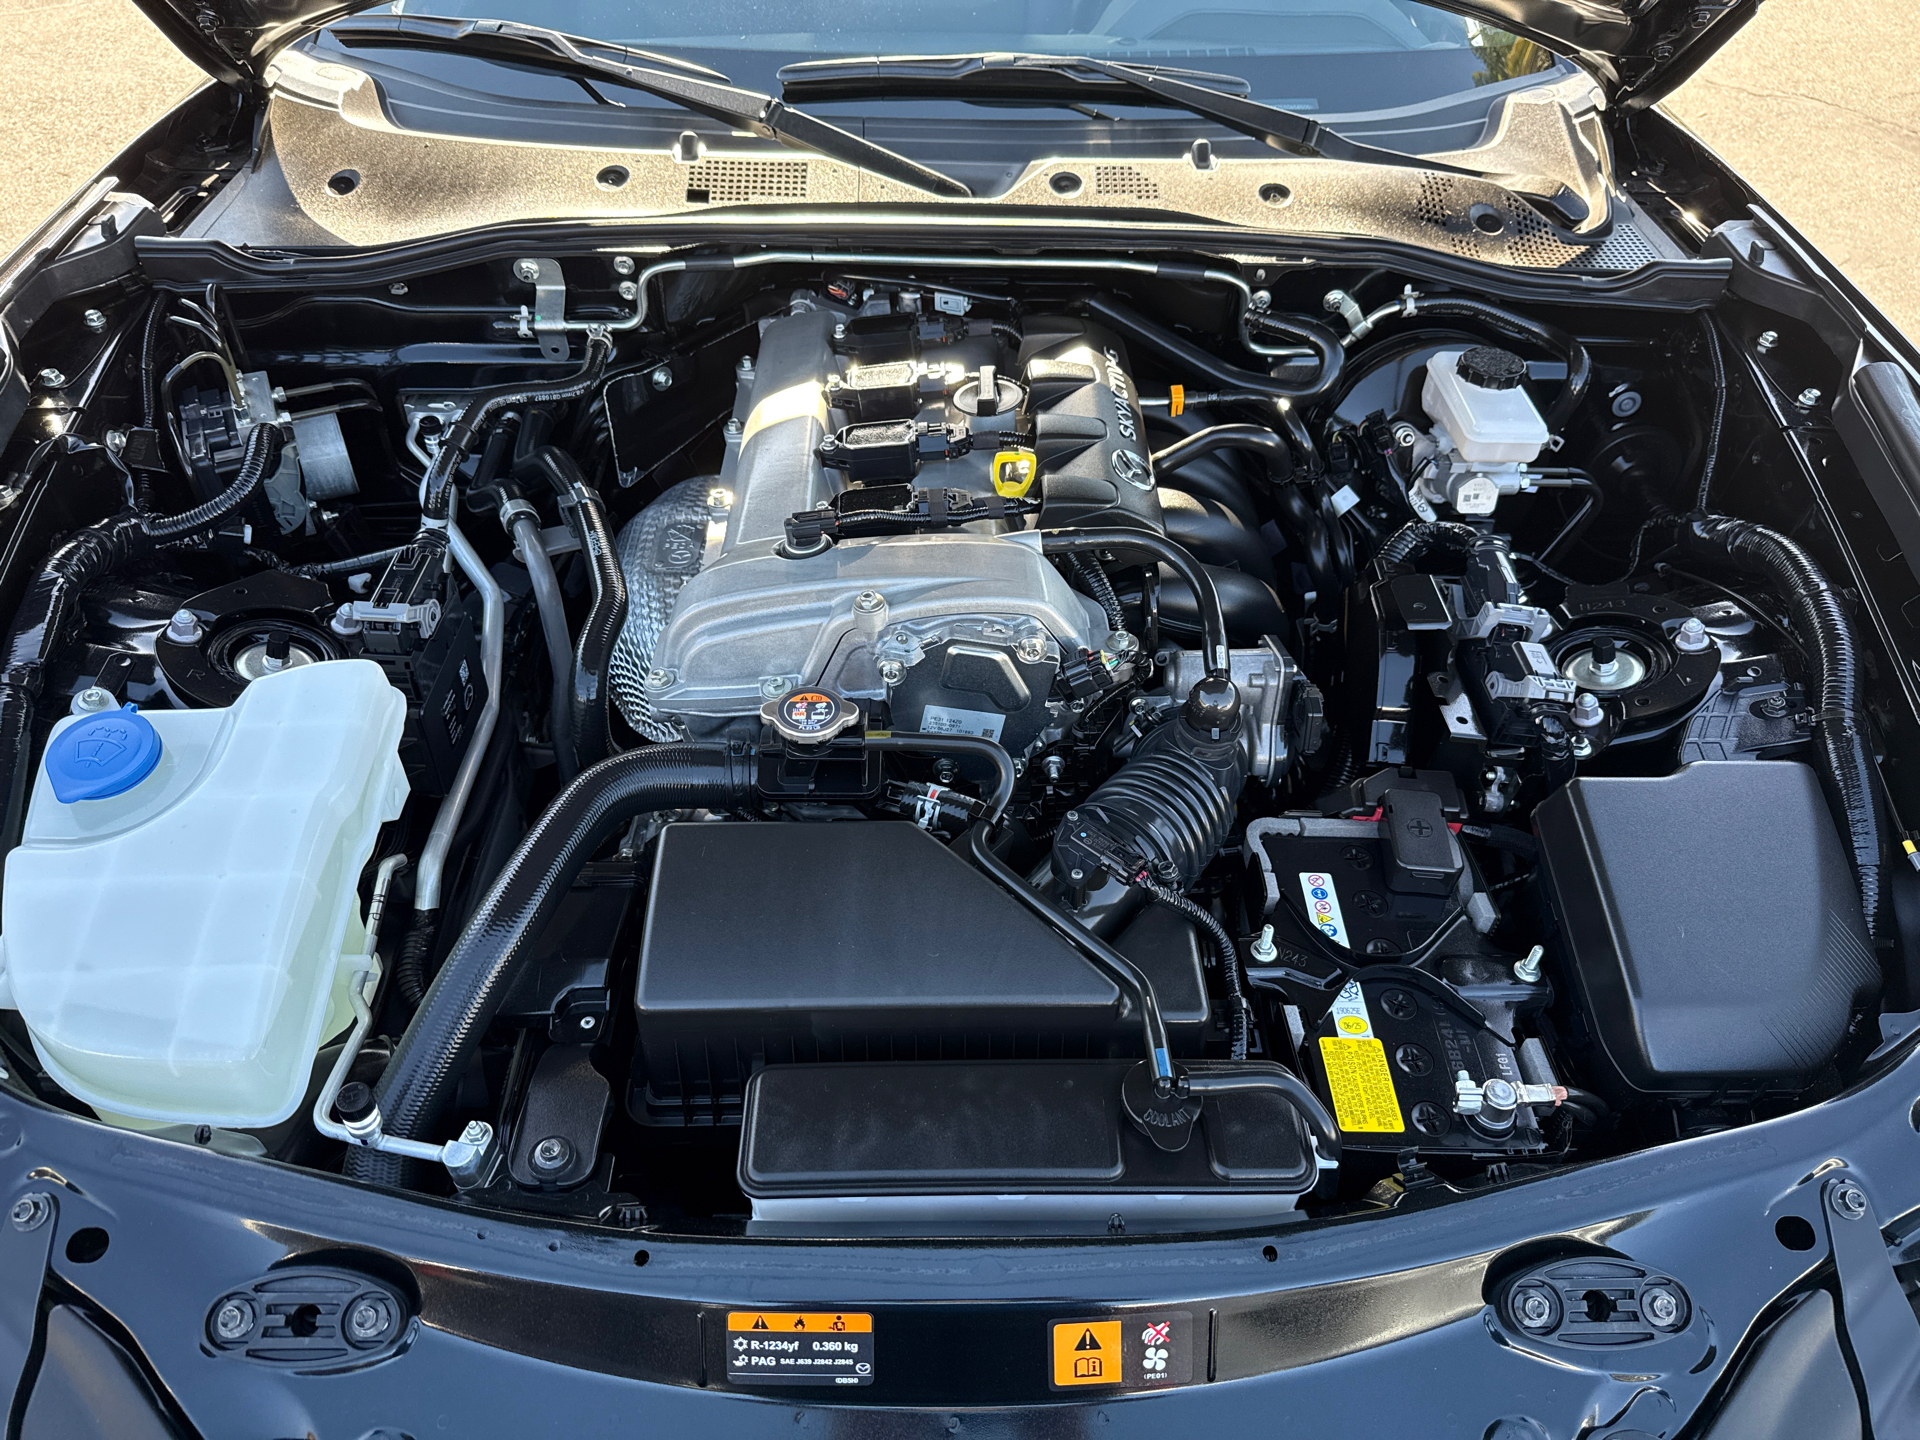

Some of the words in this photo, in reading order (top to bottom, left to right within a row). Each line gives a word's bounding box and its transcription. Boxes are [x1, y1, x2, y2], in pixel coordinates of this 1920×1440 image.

[1344, 1051, 1357, 1073] POISON
[1375, 1054, 1389, 1081] DANGER
[1143, 1107, 1191, 1128] COOLANT
[751, 1341, 799, 1352] R-1234yf
[812, 1341, 842, 1351] 0.360
[844, 1341, 859, 1353] kg
[751, 1356, 776, 1366] PAG
[1143, 1372, 1168, 1380] (PE01)
